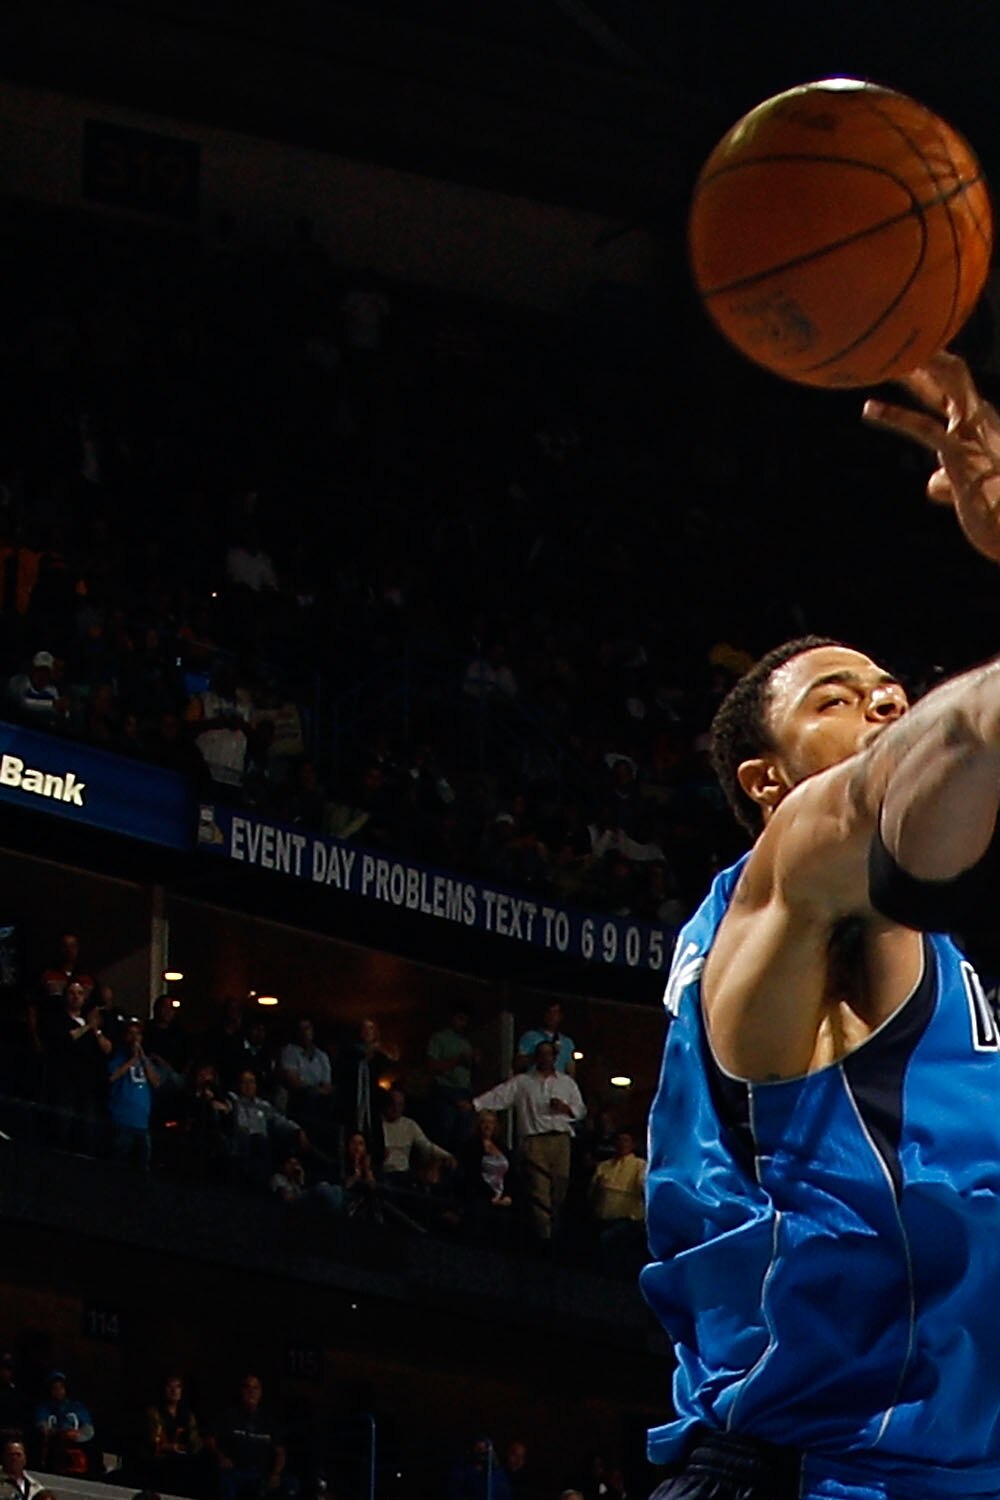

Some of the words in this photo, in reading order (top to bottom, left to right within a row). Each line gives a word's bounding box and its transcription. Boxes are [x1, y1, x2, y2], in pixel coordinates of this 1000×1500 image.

[0, 754, 86, 806] Bank
[231, 818, 305, 877] EVENT
[312, 843, 357, 889] DAY
[362, 857, 476, 926] PROBLEMS
[483, 890, 536, 943] TEXT
[542, 907, 569, 952] TO
